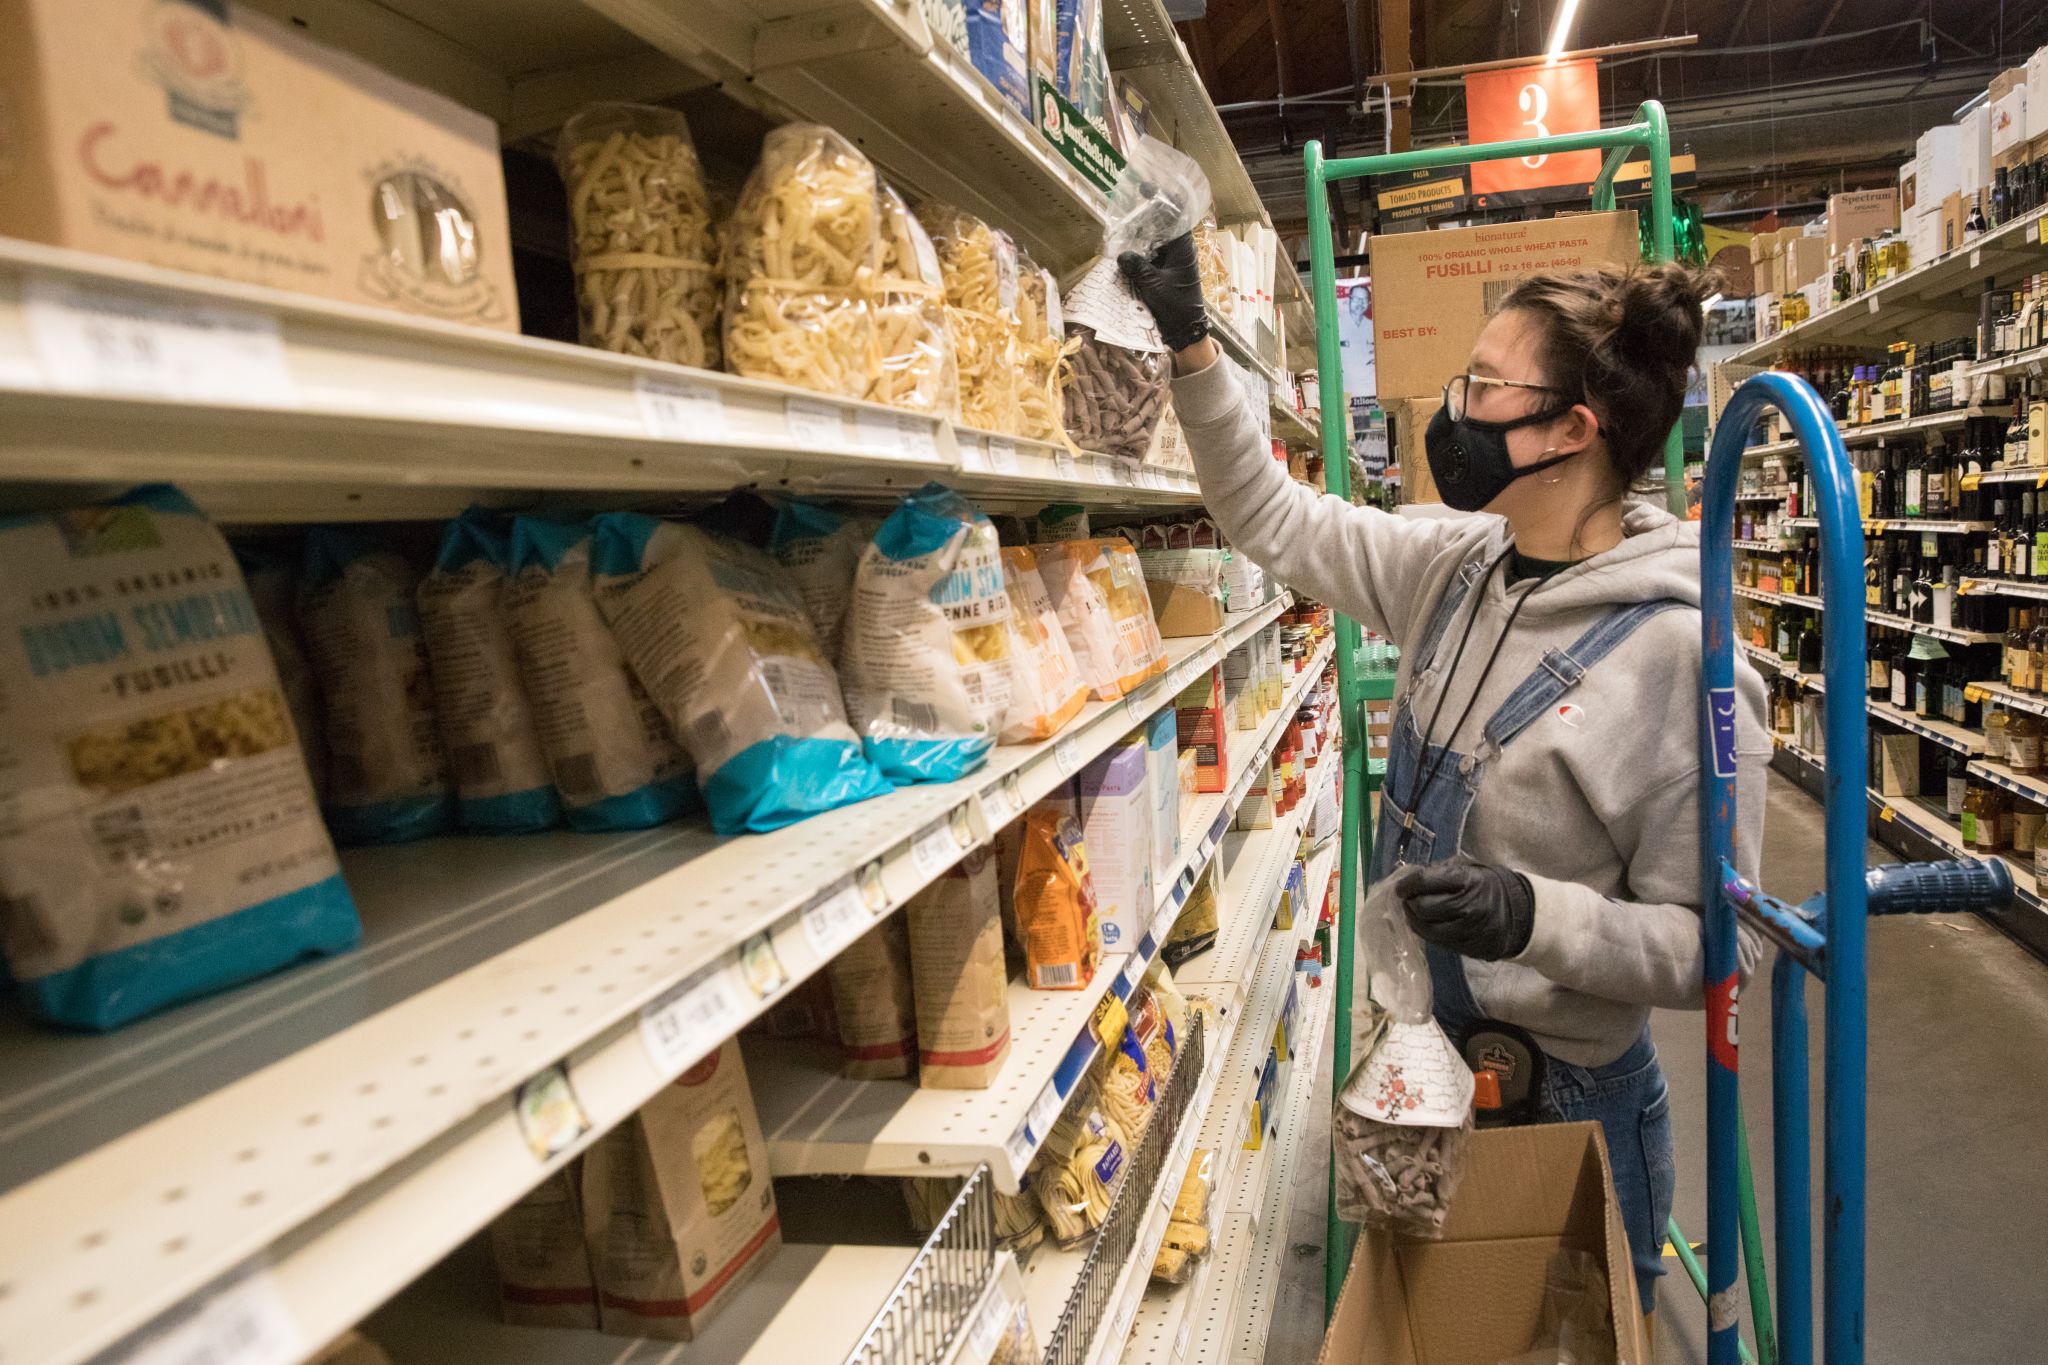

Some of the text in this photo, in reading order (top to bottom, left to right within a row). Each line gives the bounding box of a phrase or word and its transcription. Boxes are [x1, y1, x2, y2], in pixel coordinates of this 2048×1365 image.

[1518, 84, 1550, 169] 3
[1413, 170, 1429, 179] PASTA
[1478, 197, 1487, 207] C
[1841, 193, 1891, 205] Spectrum
[1392, 200, 1454, 219] PRODUCTOS DE TOMATES
[1418, 239, 1588, 262] 100% ORGANIC WHOLE WHEAT PASTA
[1426, 260, 1492, 279] FUSILLI
[1499, 264, 1510, 272] 12
[1521, 261, 1532, 269] 16
[1534, 260, 1549, 268] oz.
[1552, 257, 1581, 268] (454g)
[1383, 326, 1437, 340] BEST BY:
[943, 603, 980, 620] ENNE
[1096, 990, 1114, 1021] SALE
